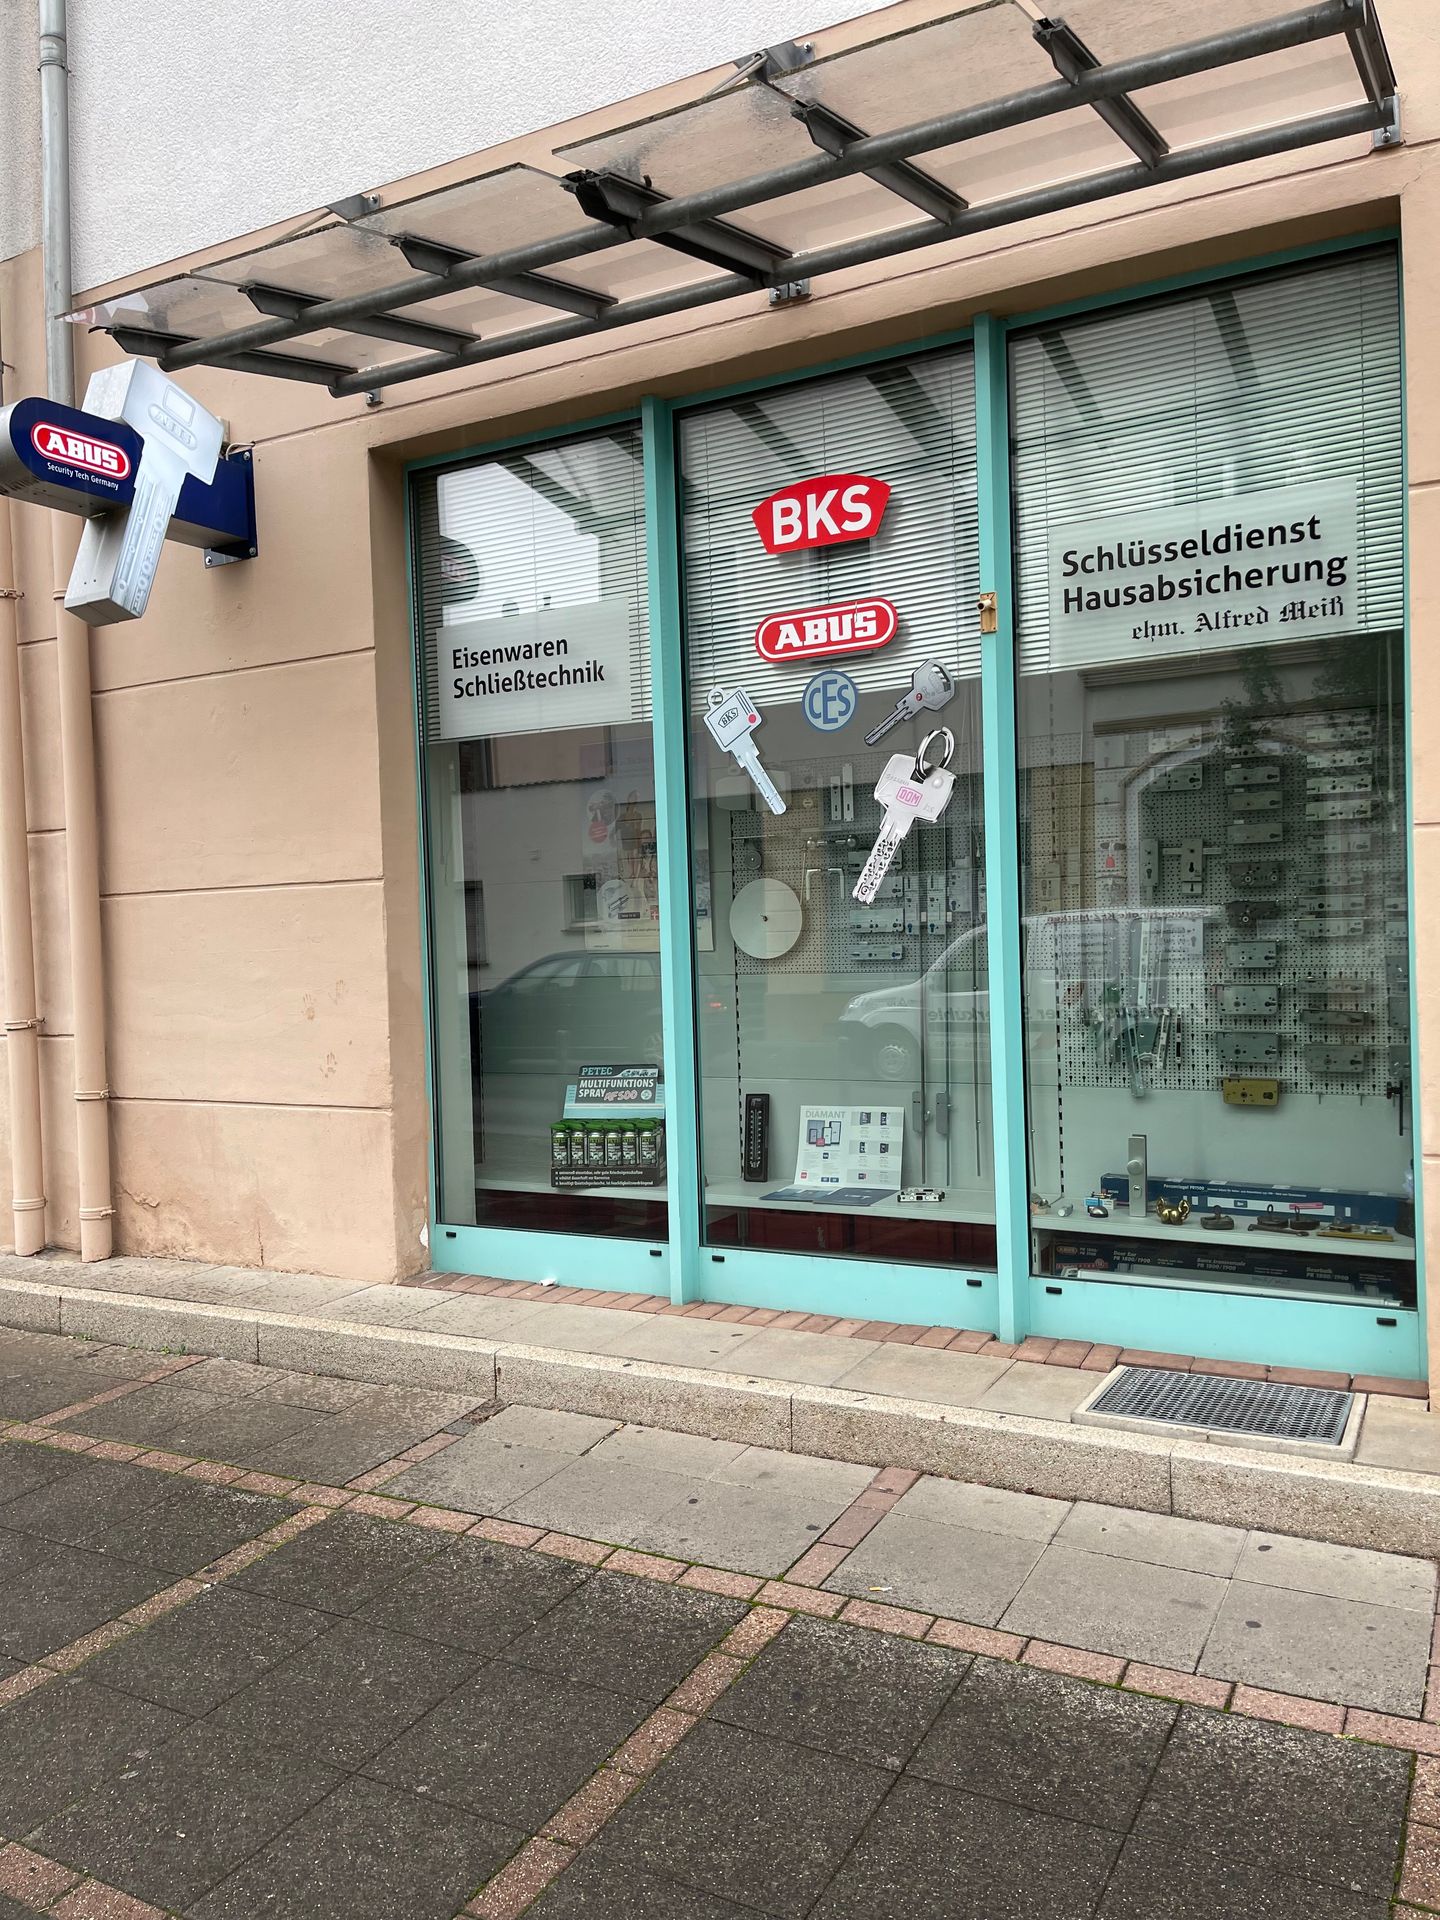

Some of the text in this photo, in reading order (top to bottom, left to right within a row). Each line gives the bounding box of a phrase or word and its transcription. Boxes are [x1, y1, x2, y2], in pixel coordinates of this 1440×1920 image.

[46, 434, 119, 471] ABUS
[47, 462, 119, 491] Security Tech Germany
[772, 484, 872, 546] BKS
[1062, 514, 1321, 577] Schlüsseldienst
[1063, 555, 1348, 614] Hausabsicherung
[775, 609, 877, 651] ABUS
[1132, 595, 1344, 642] ehm. Alfred Meiß
[452, 638, 568, 670] Eisenwaren
[453, 659, 605, 699] Schließtechnik
[721, 710, 737, 725] BKS
[808, 678, 849, 725] CES
[899, 789, 921, 805] DOM
[579, 1078, 654, 1088] MULTIFUNKTIONS
[581, 1066, 613, 1076] PETEC
[578, 1088, 606, 1098] SPRAY
[805, 1109, 846, 1119] DIAMANT
